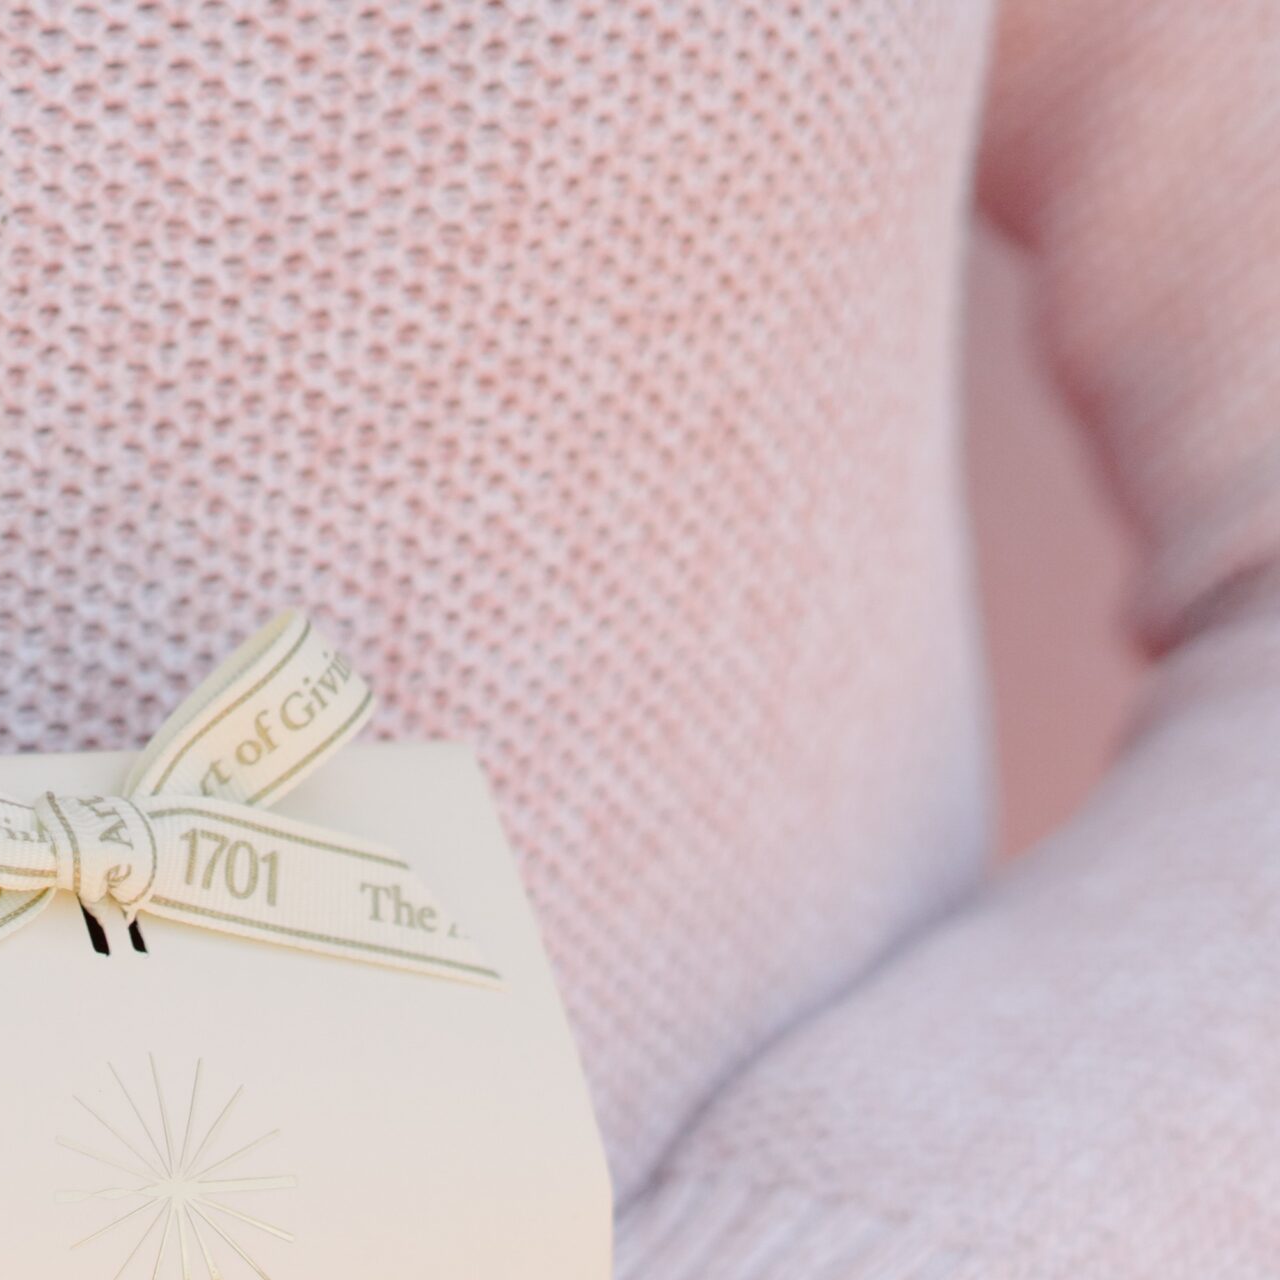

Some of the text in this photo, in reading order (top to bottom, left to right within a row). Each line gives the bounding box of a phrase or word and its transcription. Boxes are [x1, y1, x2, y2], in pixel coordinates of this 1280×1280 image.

[234, 711, 281, 766] of
[179, 826, 438, 931] 1701 The
